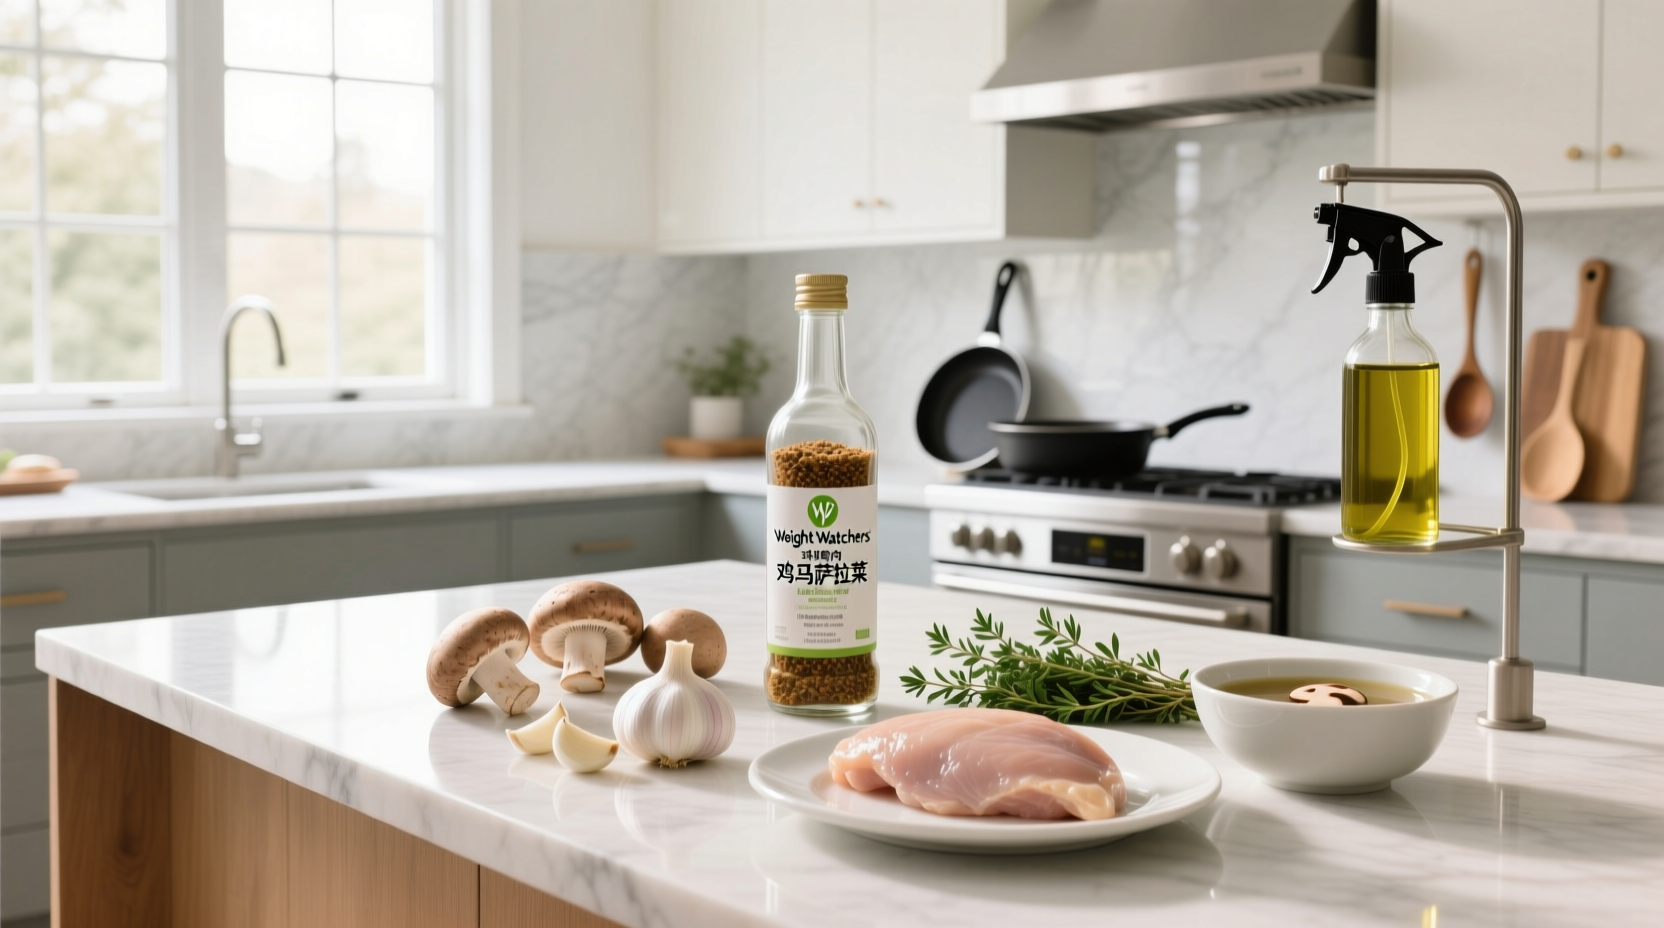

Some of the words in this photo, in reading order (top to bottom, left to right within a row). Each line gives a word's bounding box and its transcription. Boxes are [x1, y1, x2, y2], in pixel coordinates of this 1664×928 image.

[774, 529, 814, 548] Weight
[777, 561, 868, 585] 鸡马萨拉菜
